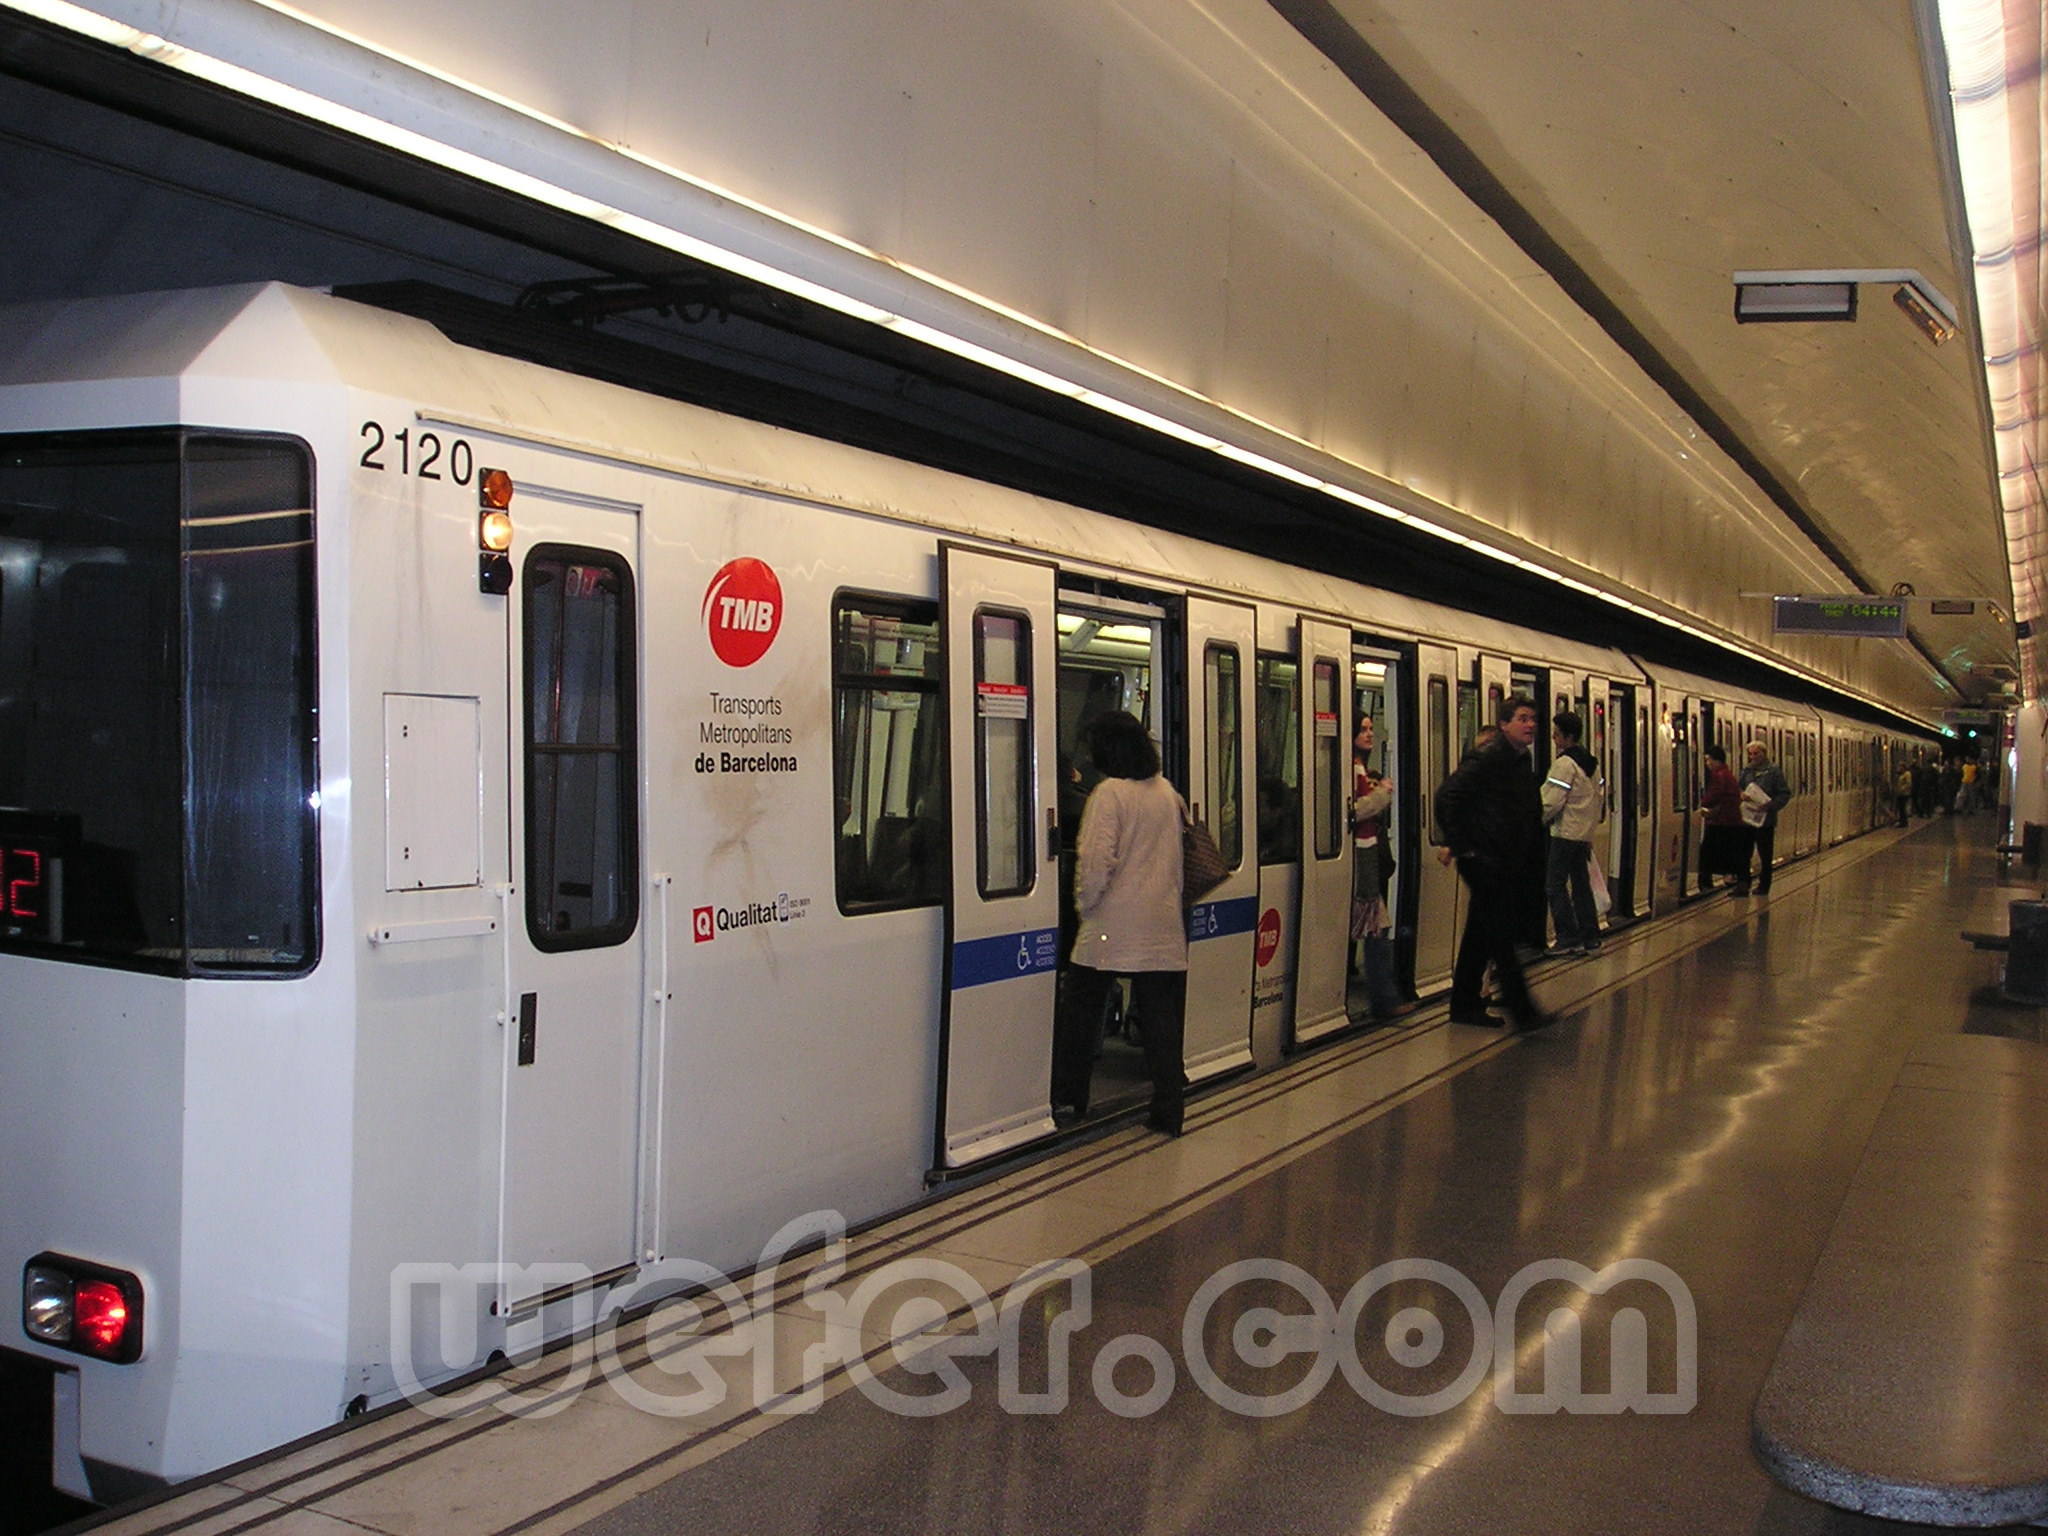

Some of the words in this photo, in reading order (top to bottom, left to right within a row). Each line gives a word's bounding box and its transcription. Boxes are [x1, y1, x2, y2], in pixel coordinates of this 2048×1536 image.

[360, 421, 473, 486] 2120
[720, 596, 774, 633] TMB
[709, 692, 782, 719] Transports
[700, 722, 792, 748] Metropolitans
[695, 752, 715, 773] de
[720, 751, 798, 773] Barcelona
[716, 901, 778, 931] Qualitat
